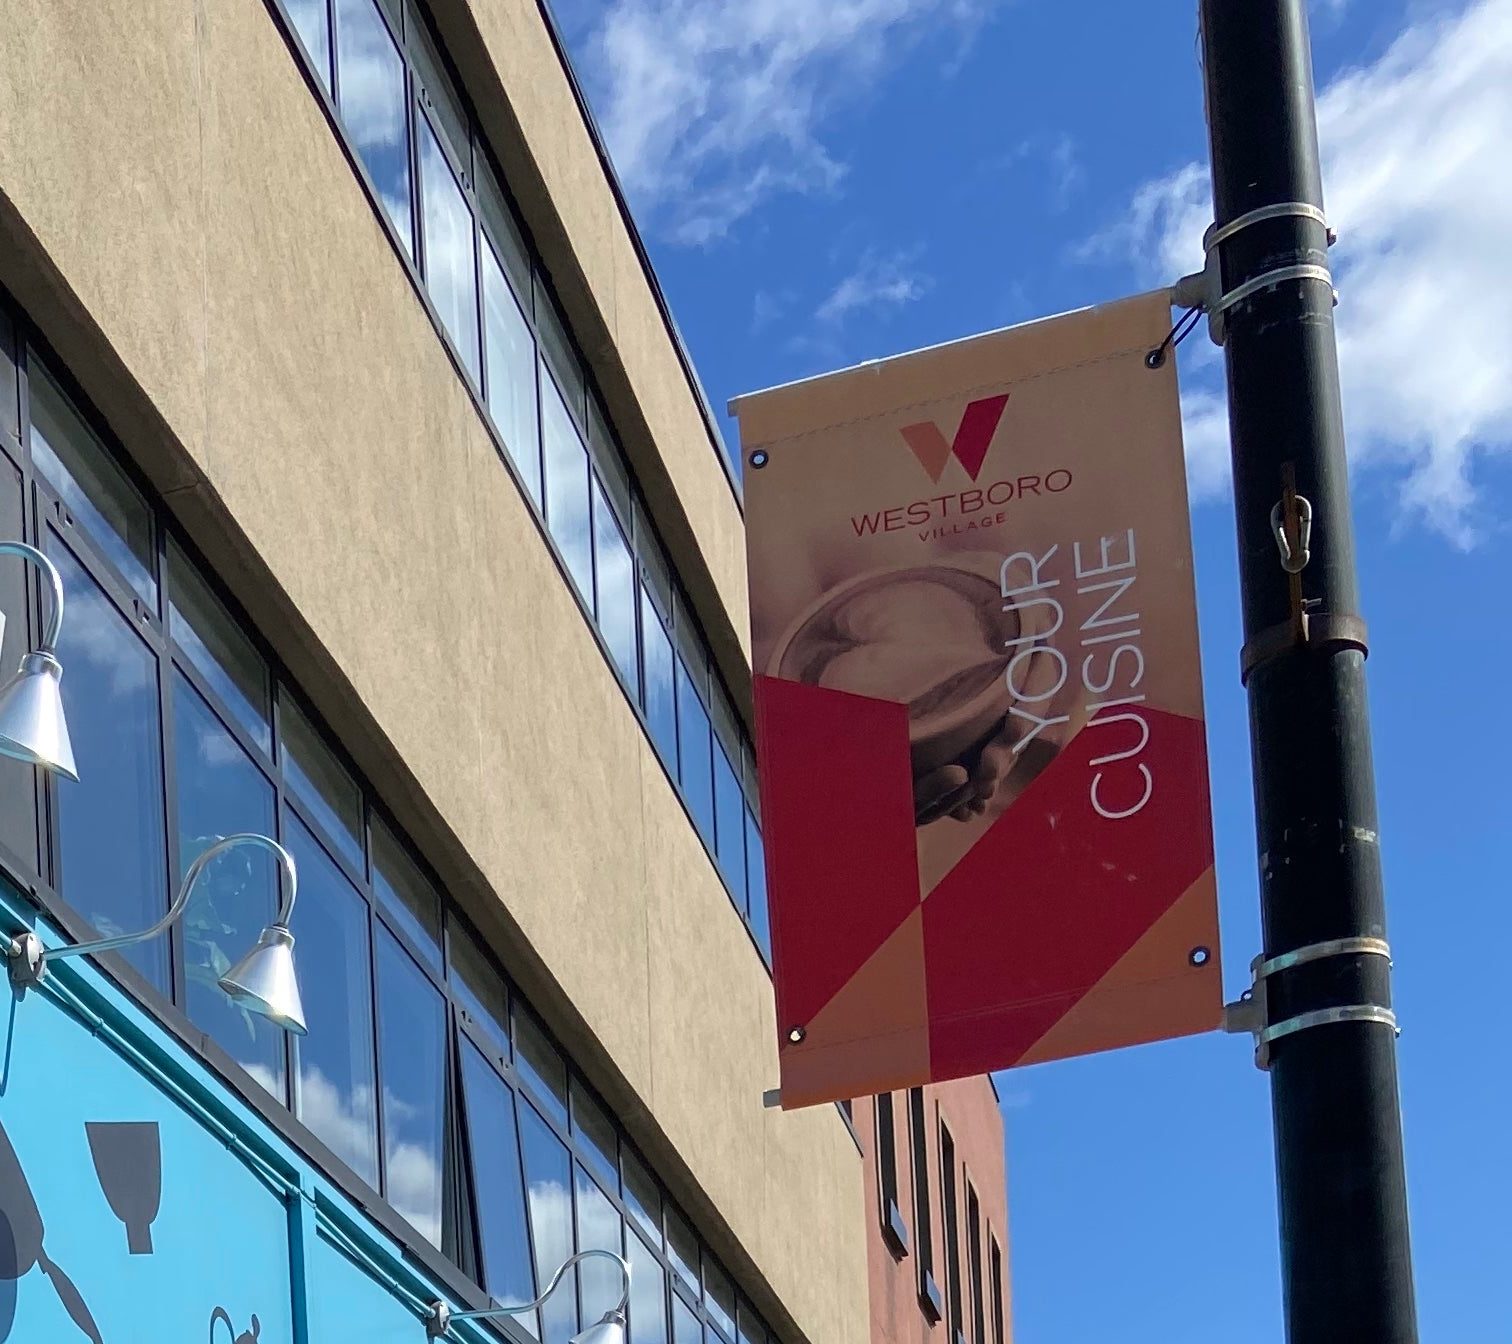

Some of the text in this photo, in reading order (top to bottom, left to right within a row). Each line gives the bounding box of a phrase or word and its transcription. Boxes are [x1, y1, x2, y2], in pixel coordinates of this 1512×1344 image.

[850, 468, 1073, 537] WESTBORO
[918, 511, 1007, 542] VILLAGE
[999, 543, 1070, 754] YOUR
[1073, 527, 1153, 819] CUISINE
